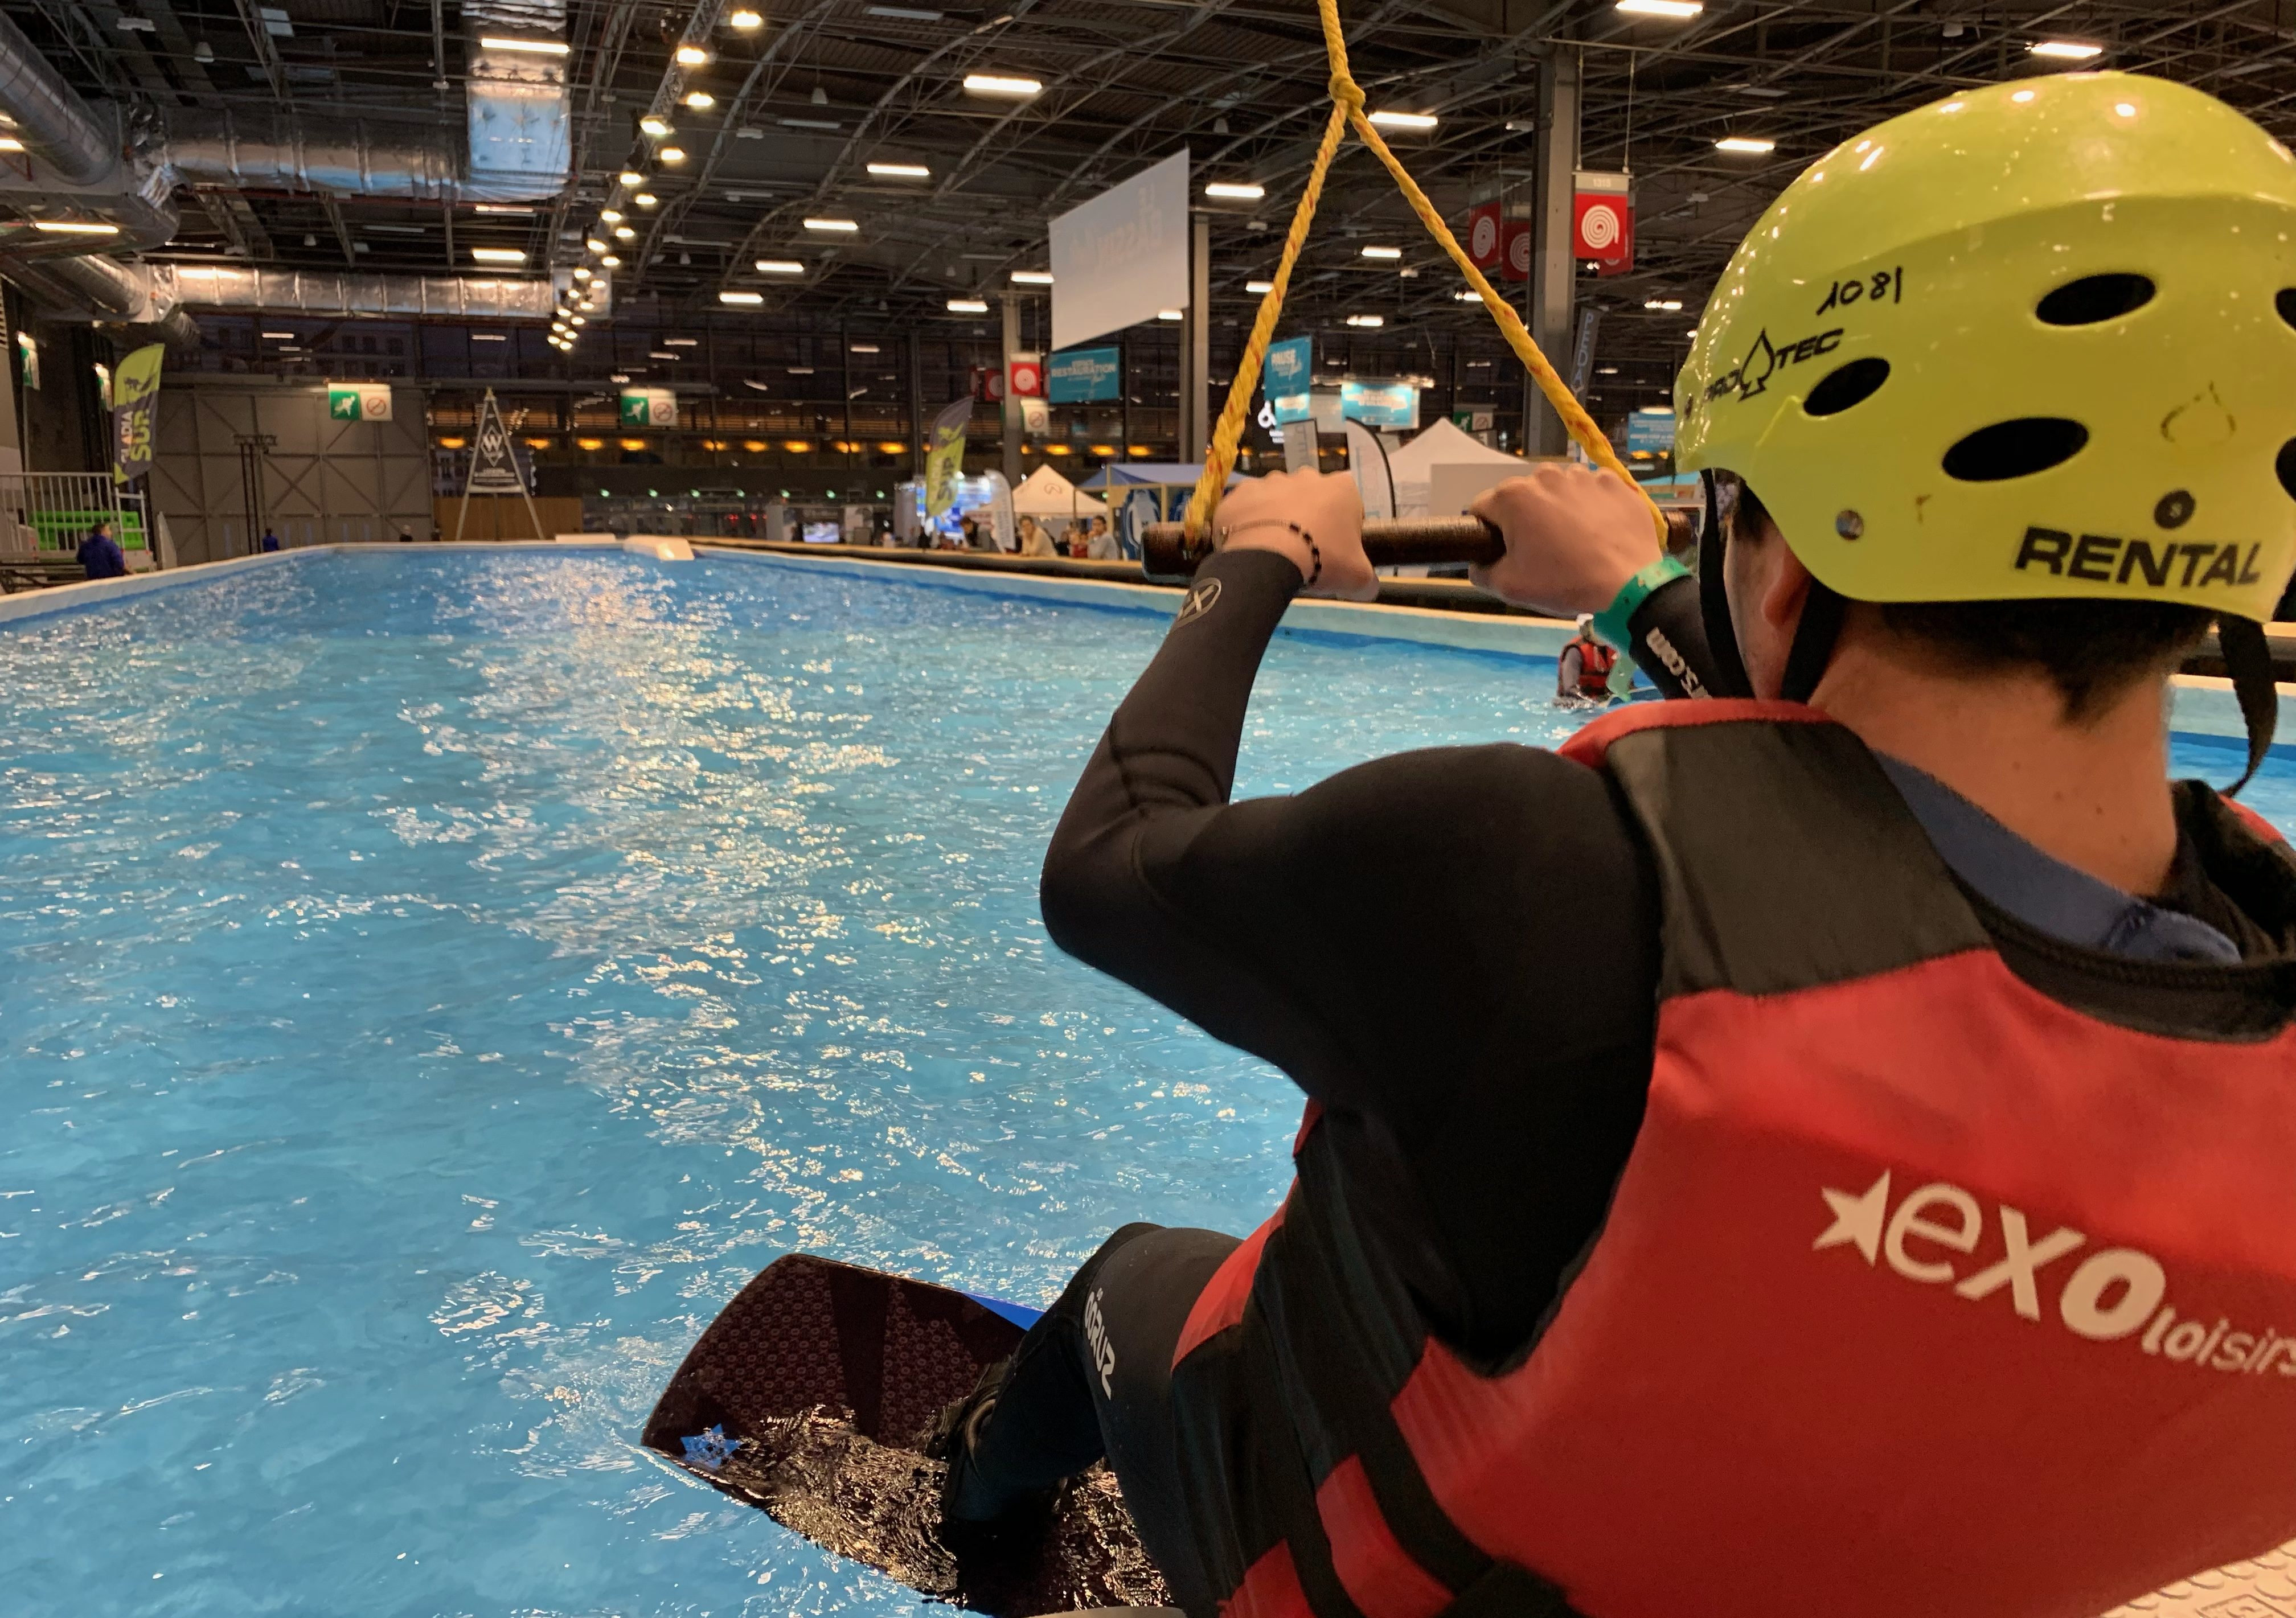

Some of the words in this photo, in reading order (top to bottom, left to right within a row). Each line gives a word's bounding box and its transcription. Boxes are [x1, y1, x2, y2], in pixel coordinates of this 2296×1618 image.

[1817, 266, 1903, 315] 1081
[1776, 327, 1844, 370] TEC
[2015, 526, 2261, 588] RENTAL
